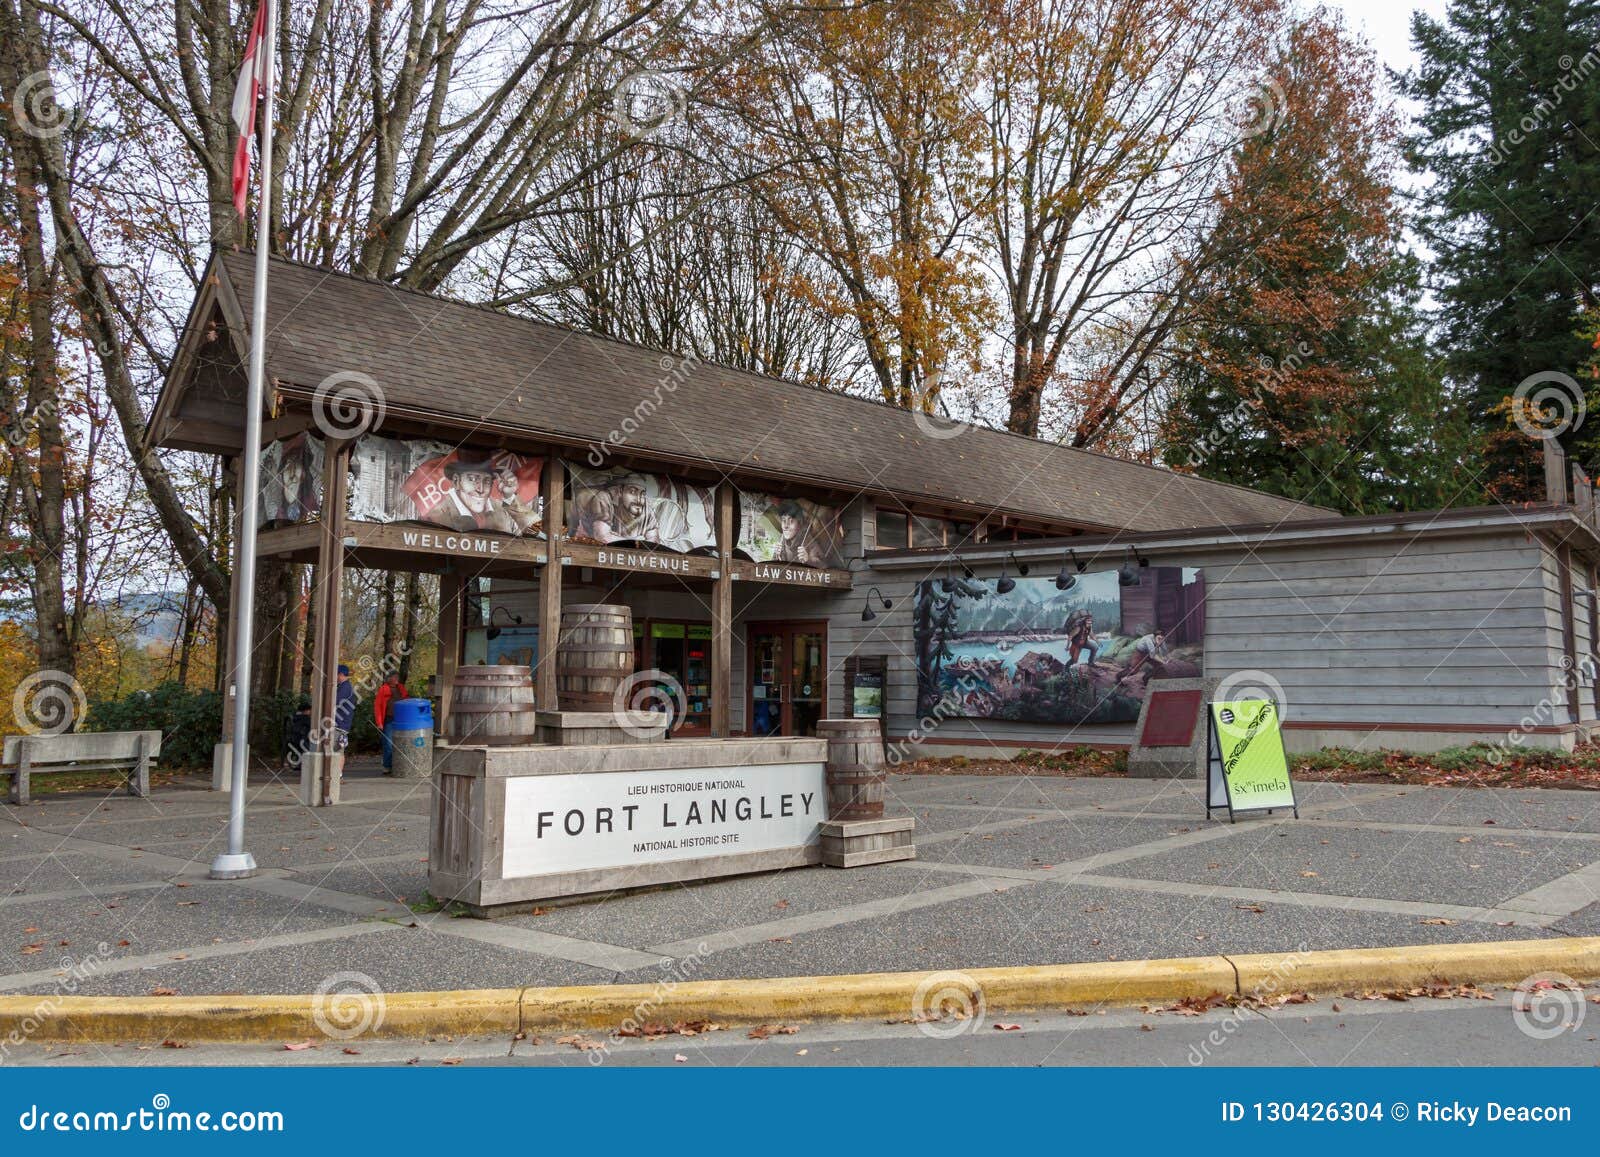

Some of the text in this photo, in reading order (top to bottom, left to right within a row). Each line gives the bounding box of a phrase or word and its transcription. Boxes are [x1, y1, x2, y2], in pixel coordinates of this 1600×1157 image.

[403, 531, 501, 553] WELCOME
[598, 551, 690, 571] BIENVENUE
[628, 780, 745, 795] LIEU HISTORIQUE NATIONAL
[537, 792, 814, 839] FORT LANGLEY
[633, 834, 739, 852] NATIONAL HISTORIC SITE
